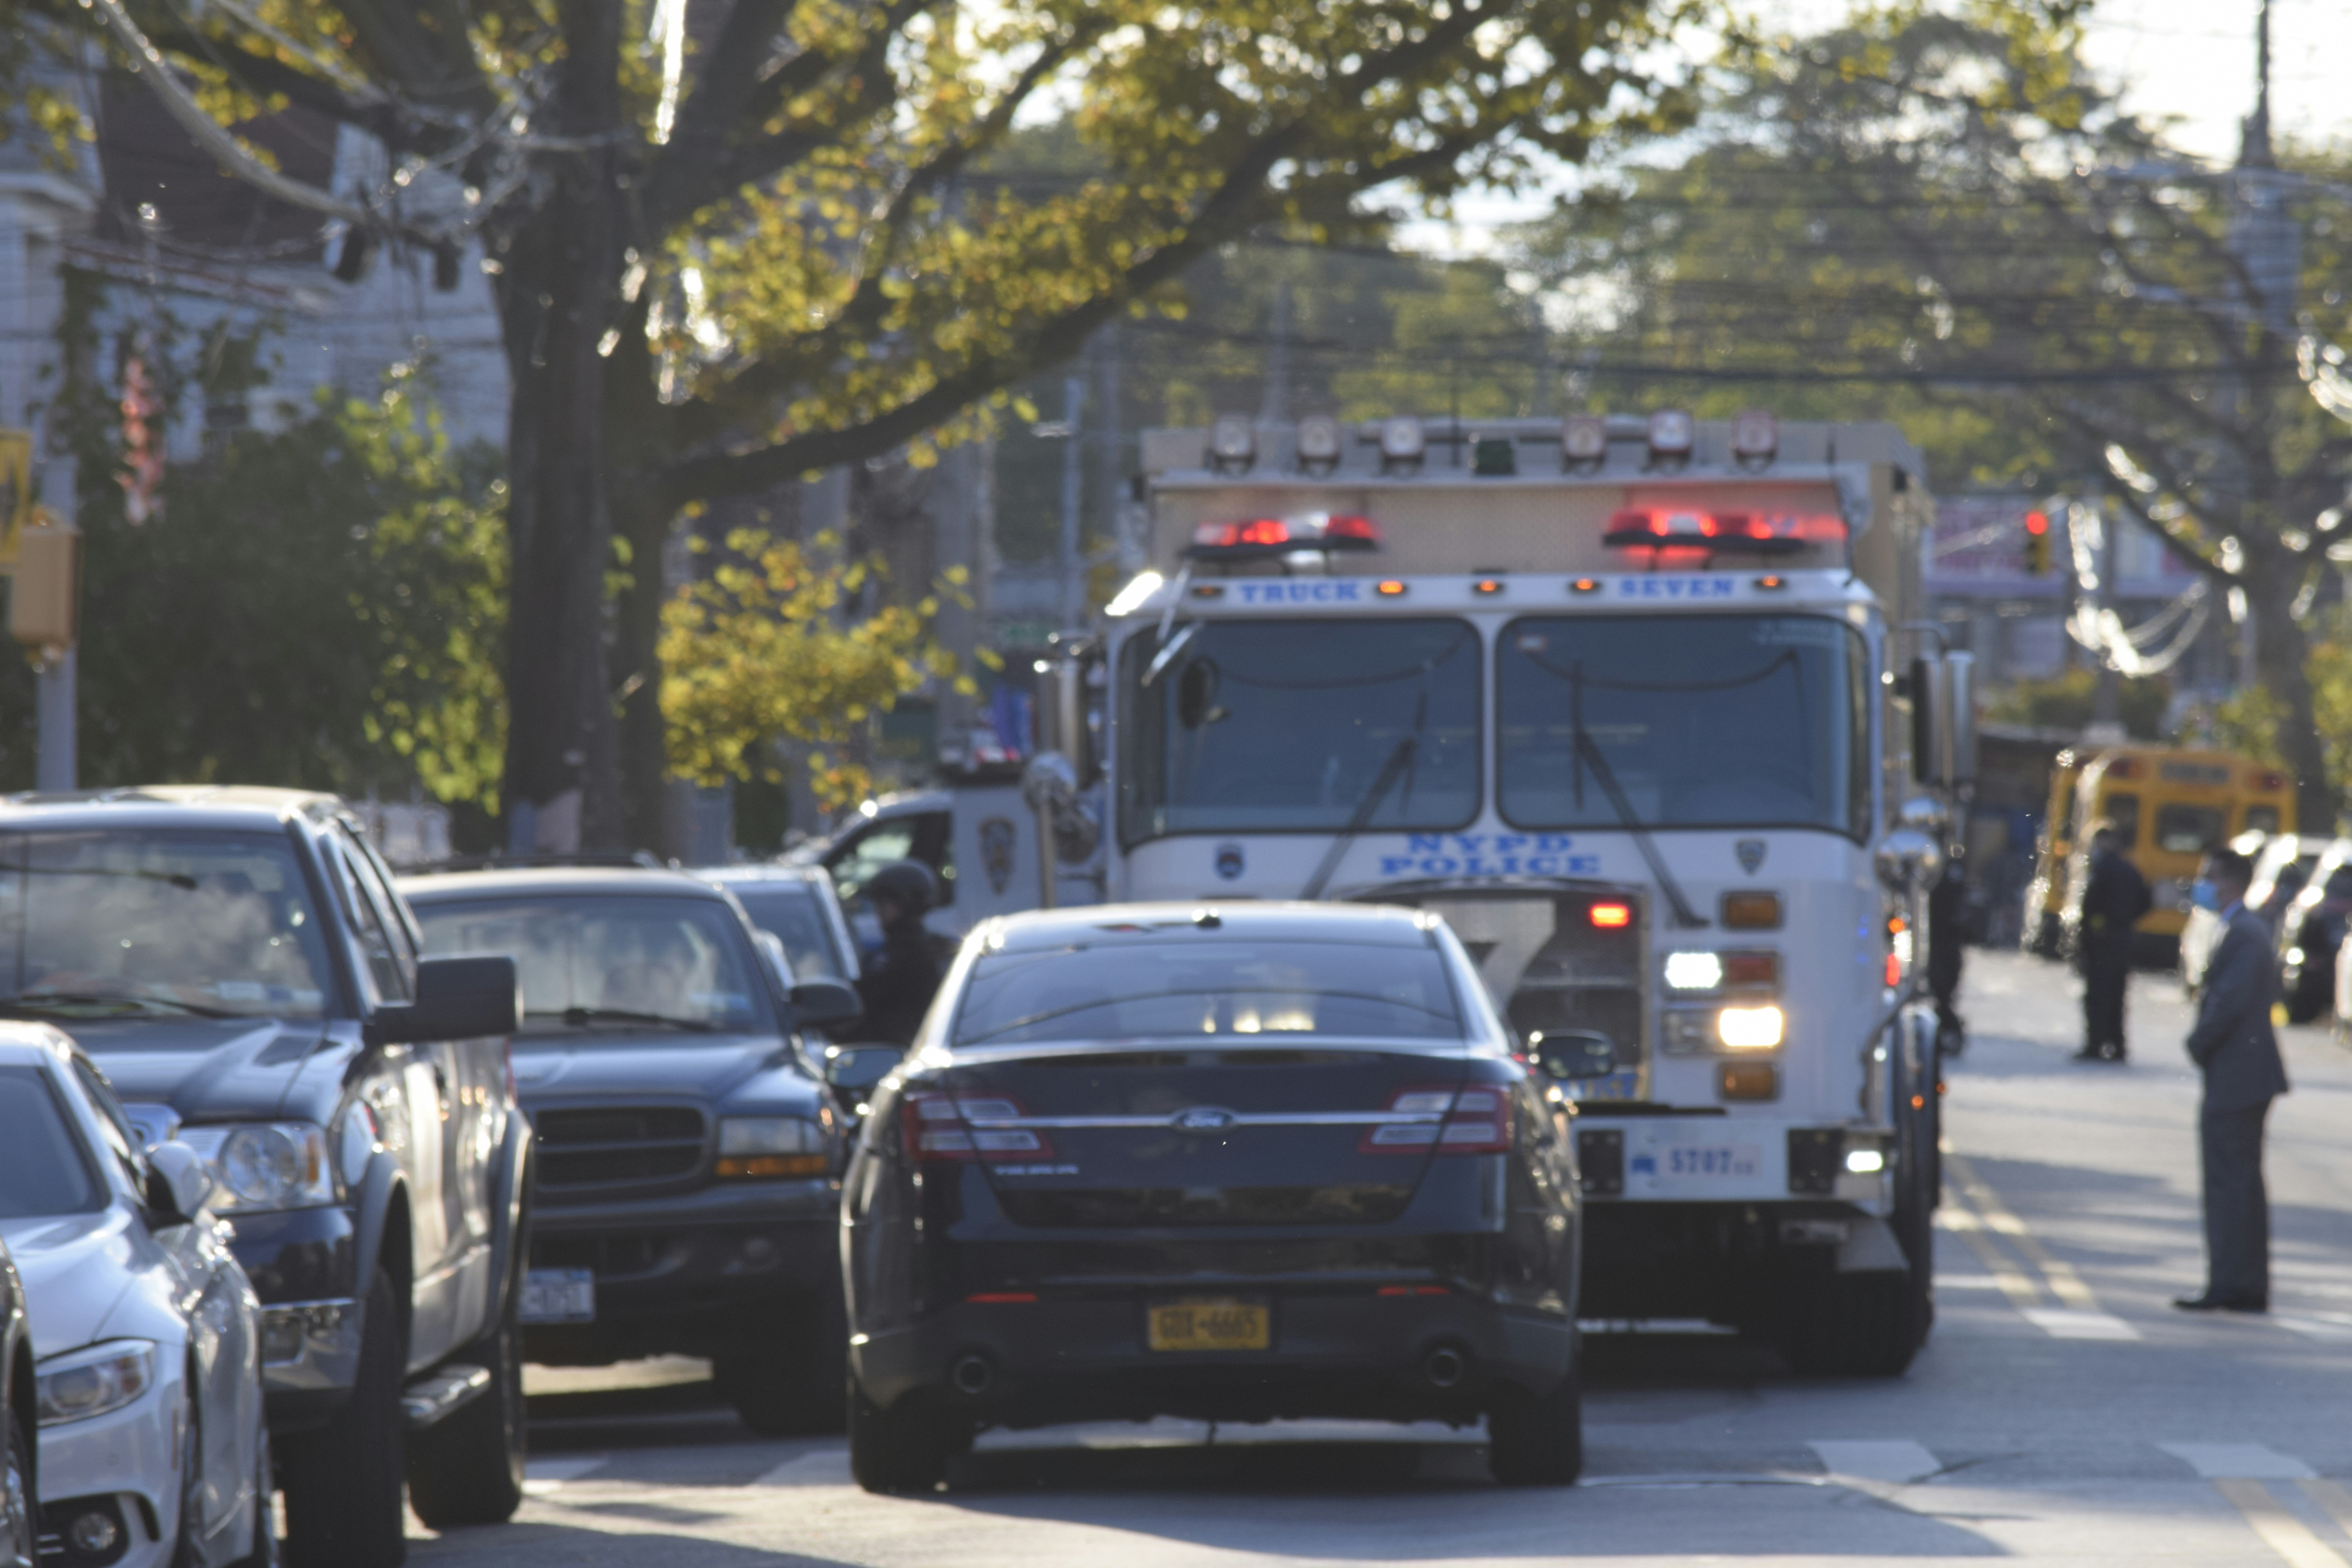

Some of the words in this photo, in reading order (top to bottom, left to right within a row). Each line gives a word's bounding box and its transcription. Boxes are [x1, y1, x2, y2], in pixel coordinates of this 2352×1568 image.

[1240, 582, 1359, 603] TRUCK
[1619, 577, 1735, 598] SEVEN
[1407, 834, 1572, 853] NYPD
[1378, 856, 1601, 875] POLICE
